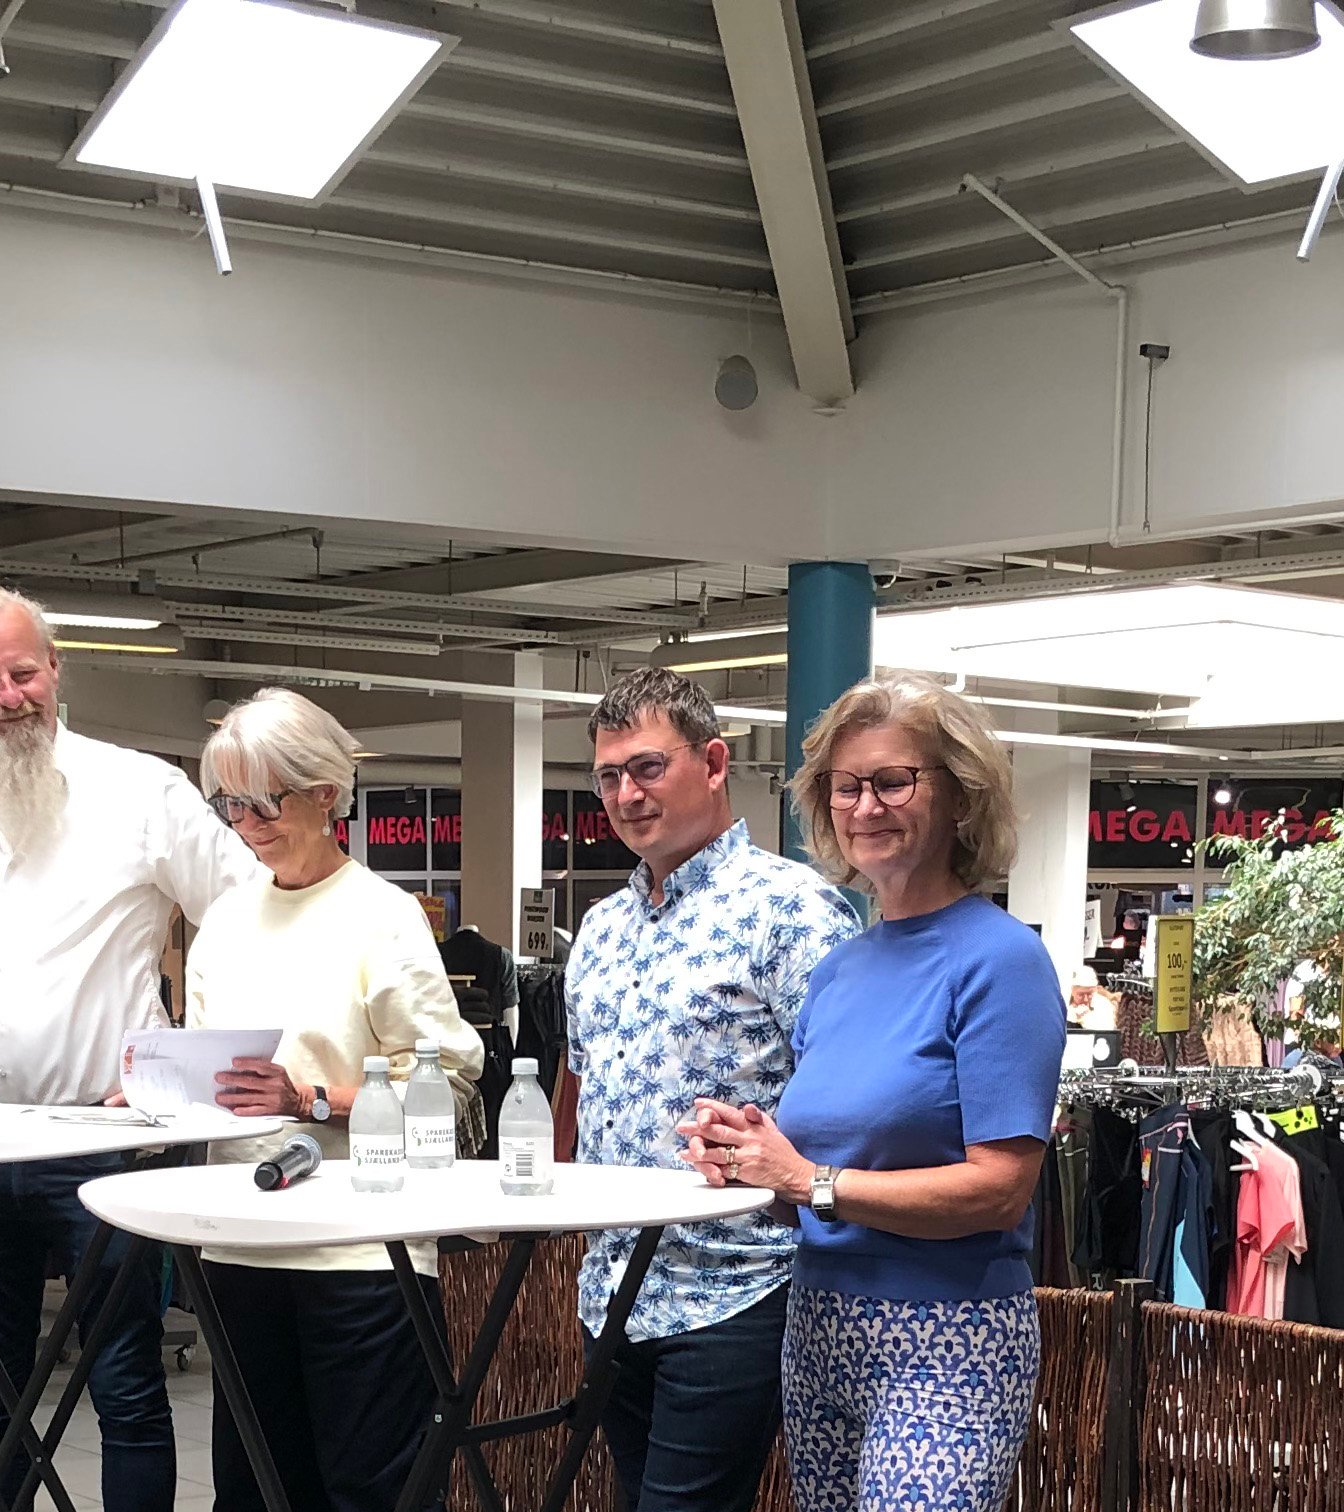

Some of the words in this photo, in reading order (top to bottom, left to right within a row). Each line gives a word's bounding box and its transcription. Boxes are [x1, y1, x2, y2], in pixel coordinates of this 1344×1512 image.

[369, 815, 426, 845] MEGA
[433, 814, 462, 843] ME
[1167, 952, 1188, 971] 100,-
